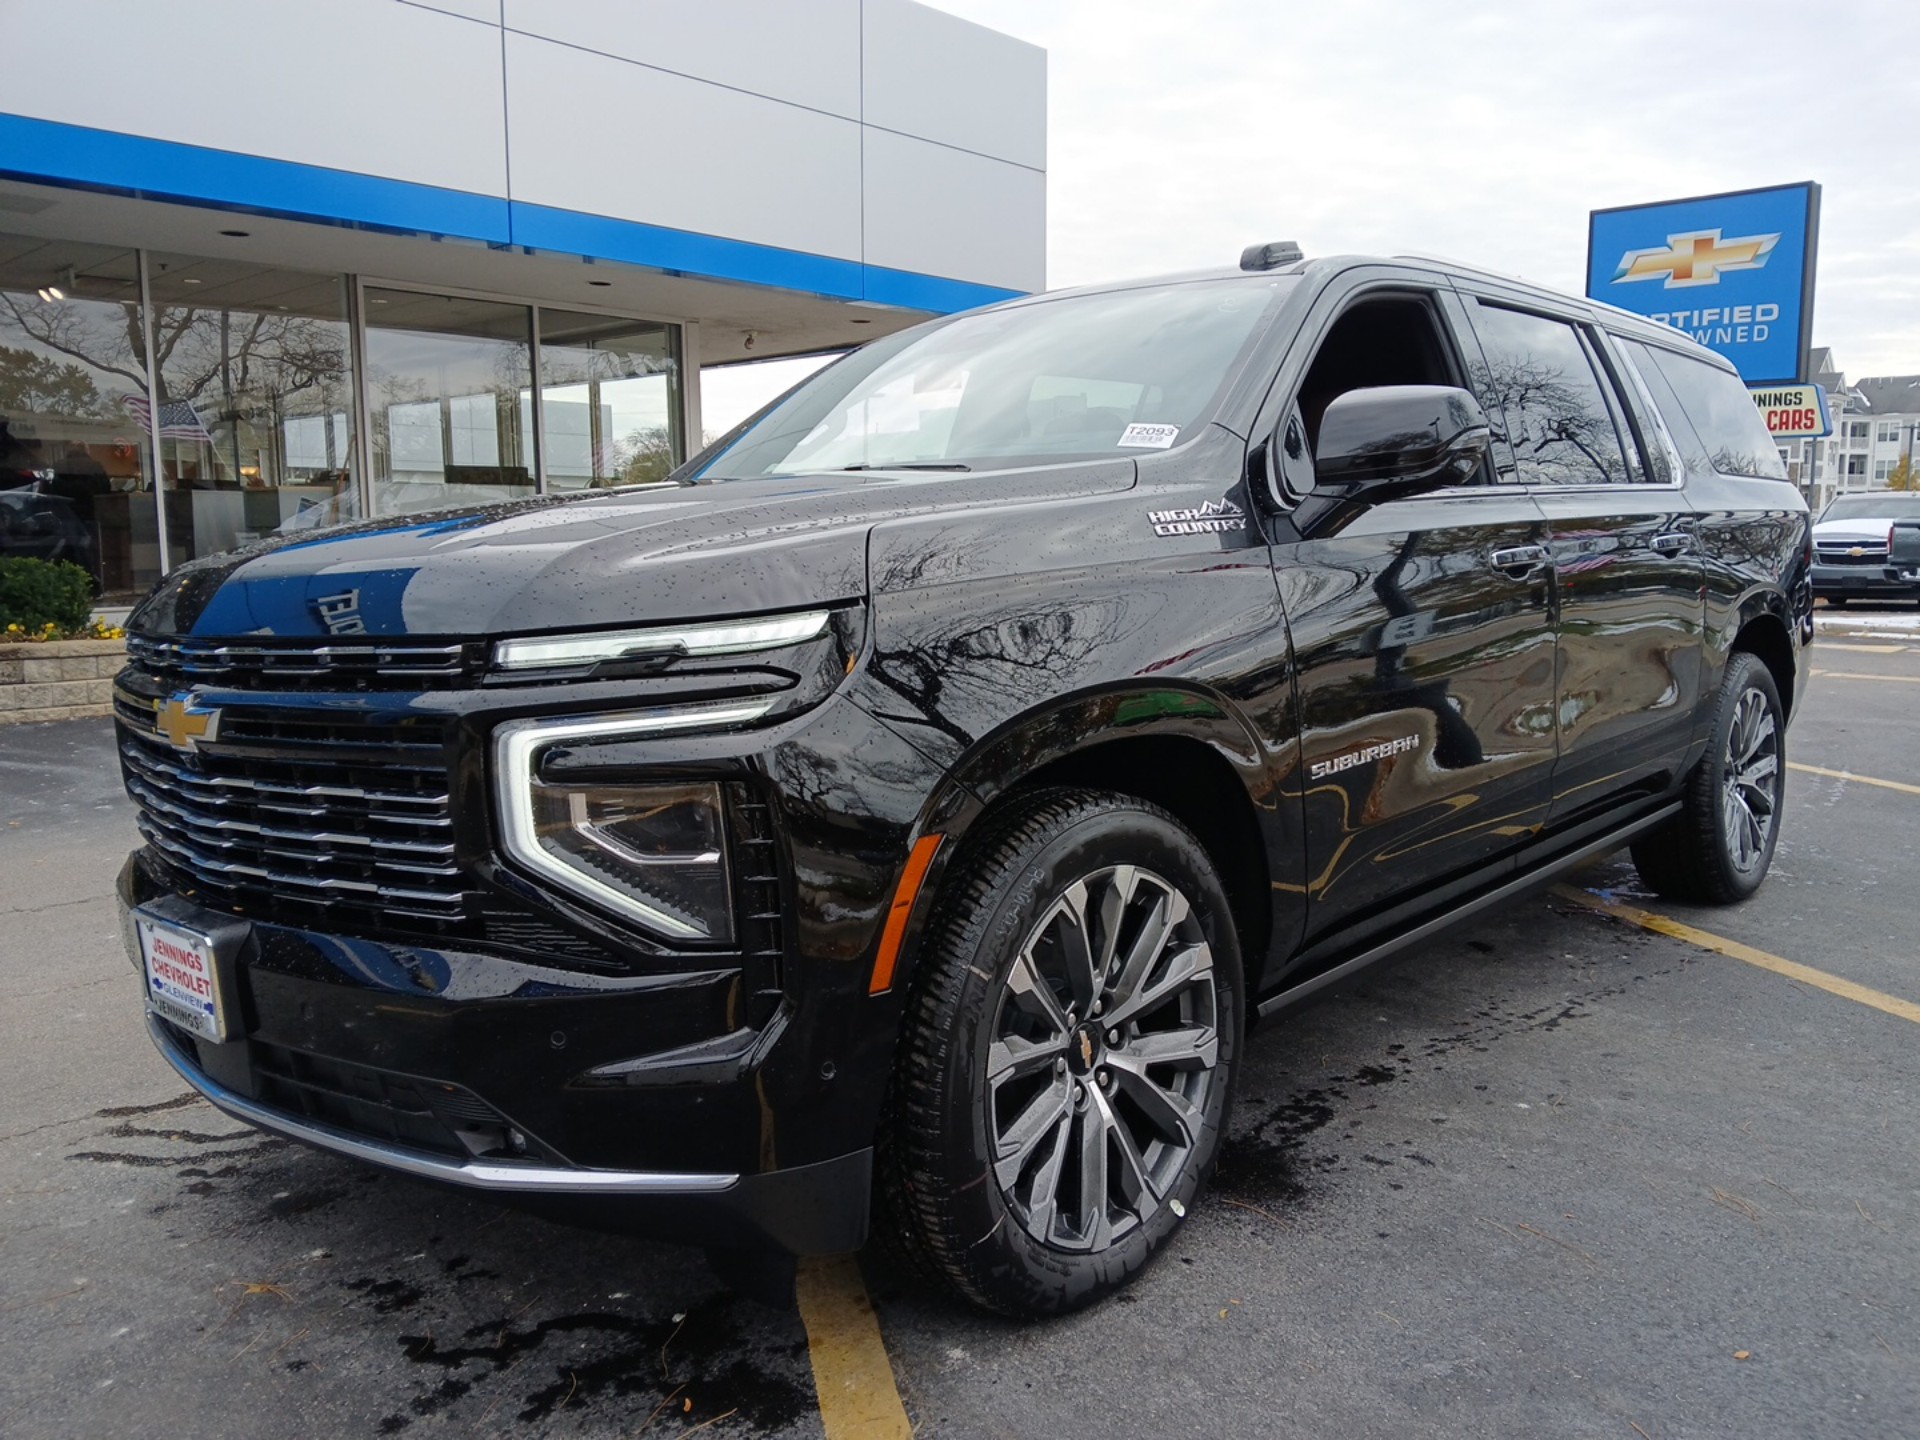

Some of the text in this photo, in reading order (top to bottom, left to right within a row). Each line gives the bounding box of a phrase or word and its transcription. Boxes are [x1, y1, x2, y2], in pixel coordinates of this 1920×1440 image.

[1646, 303, 1779, 328] RTIFIED
[1130, 426, 1175, 437] T2093
[1767, 408, 1815, 431] CARS
[1147, 508, 1201, 524] HIGH
[1154, 518, 1246, 537] COUNTRY
[1311, 734, 1420, 780] SUBURBAN
[153, 938, 203, 973] JENNINGS
[151, 956, 211, 997] CHEVROLET
[163, 982, 205, 1009] GLENVIEW
